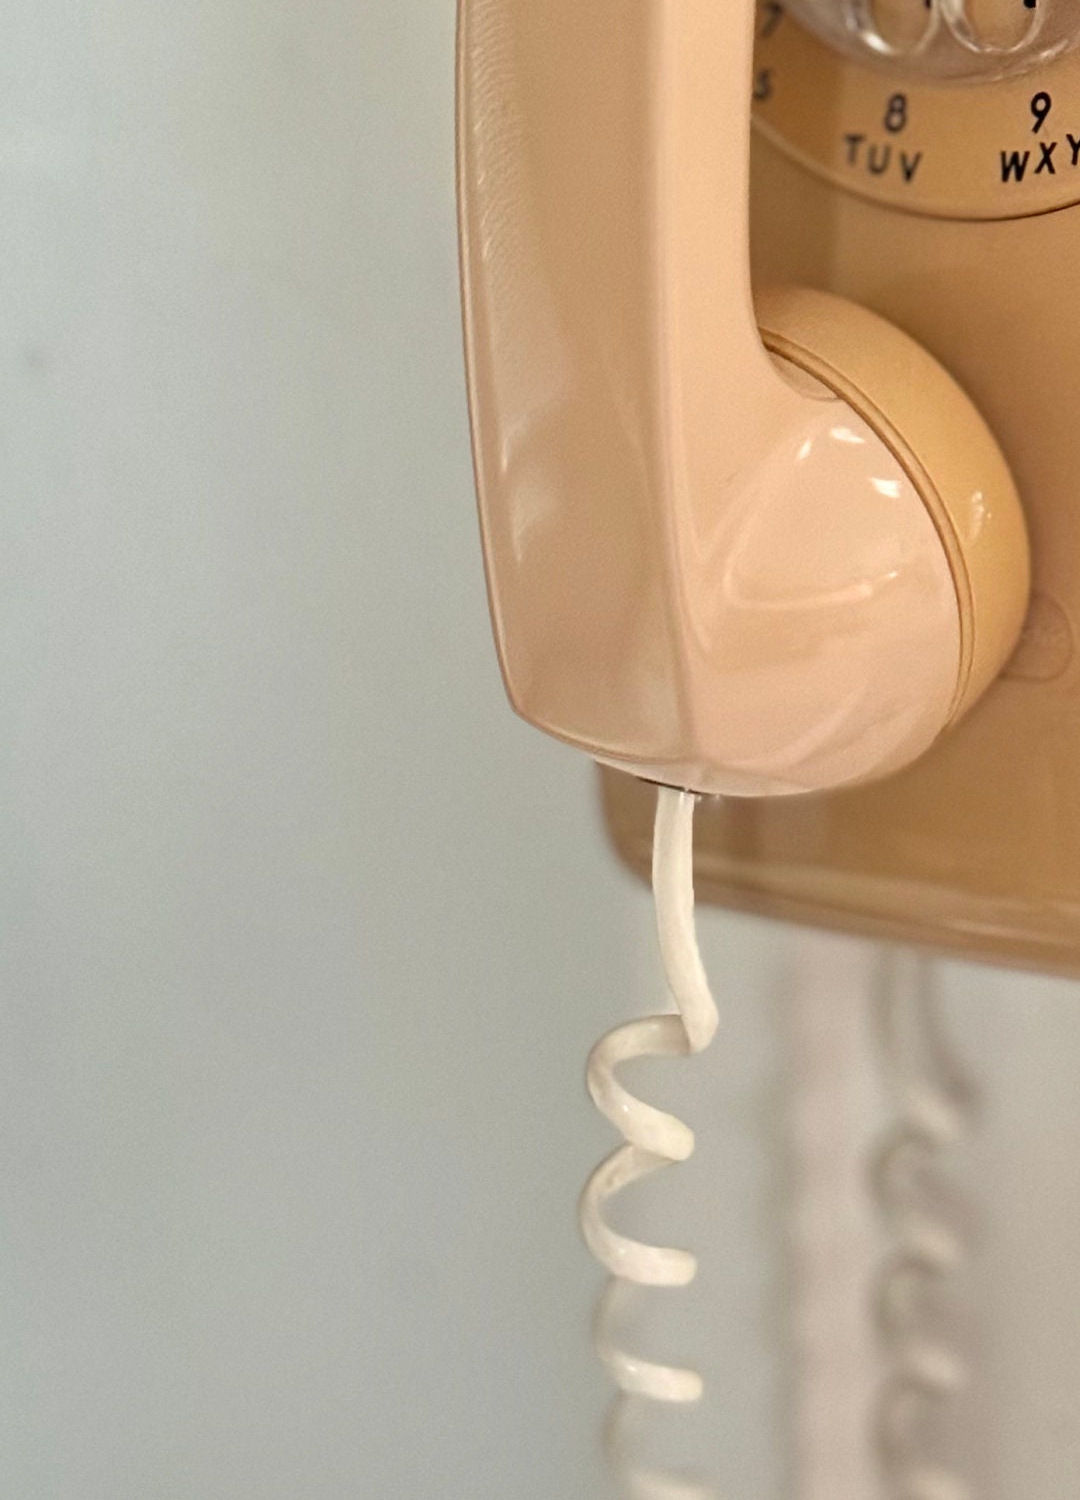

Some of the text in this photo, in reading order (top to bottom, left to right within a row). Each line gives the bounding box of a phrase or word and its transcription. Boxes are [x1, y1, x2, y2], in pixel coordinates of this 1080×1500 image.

[884, 93, 907, 133] 8
[1030, 92, 1052, 133] 9
[845, 135, 921, 182] TUV
